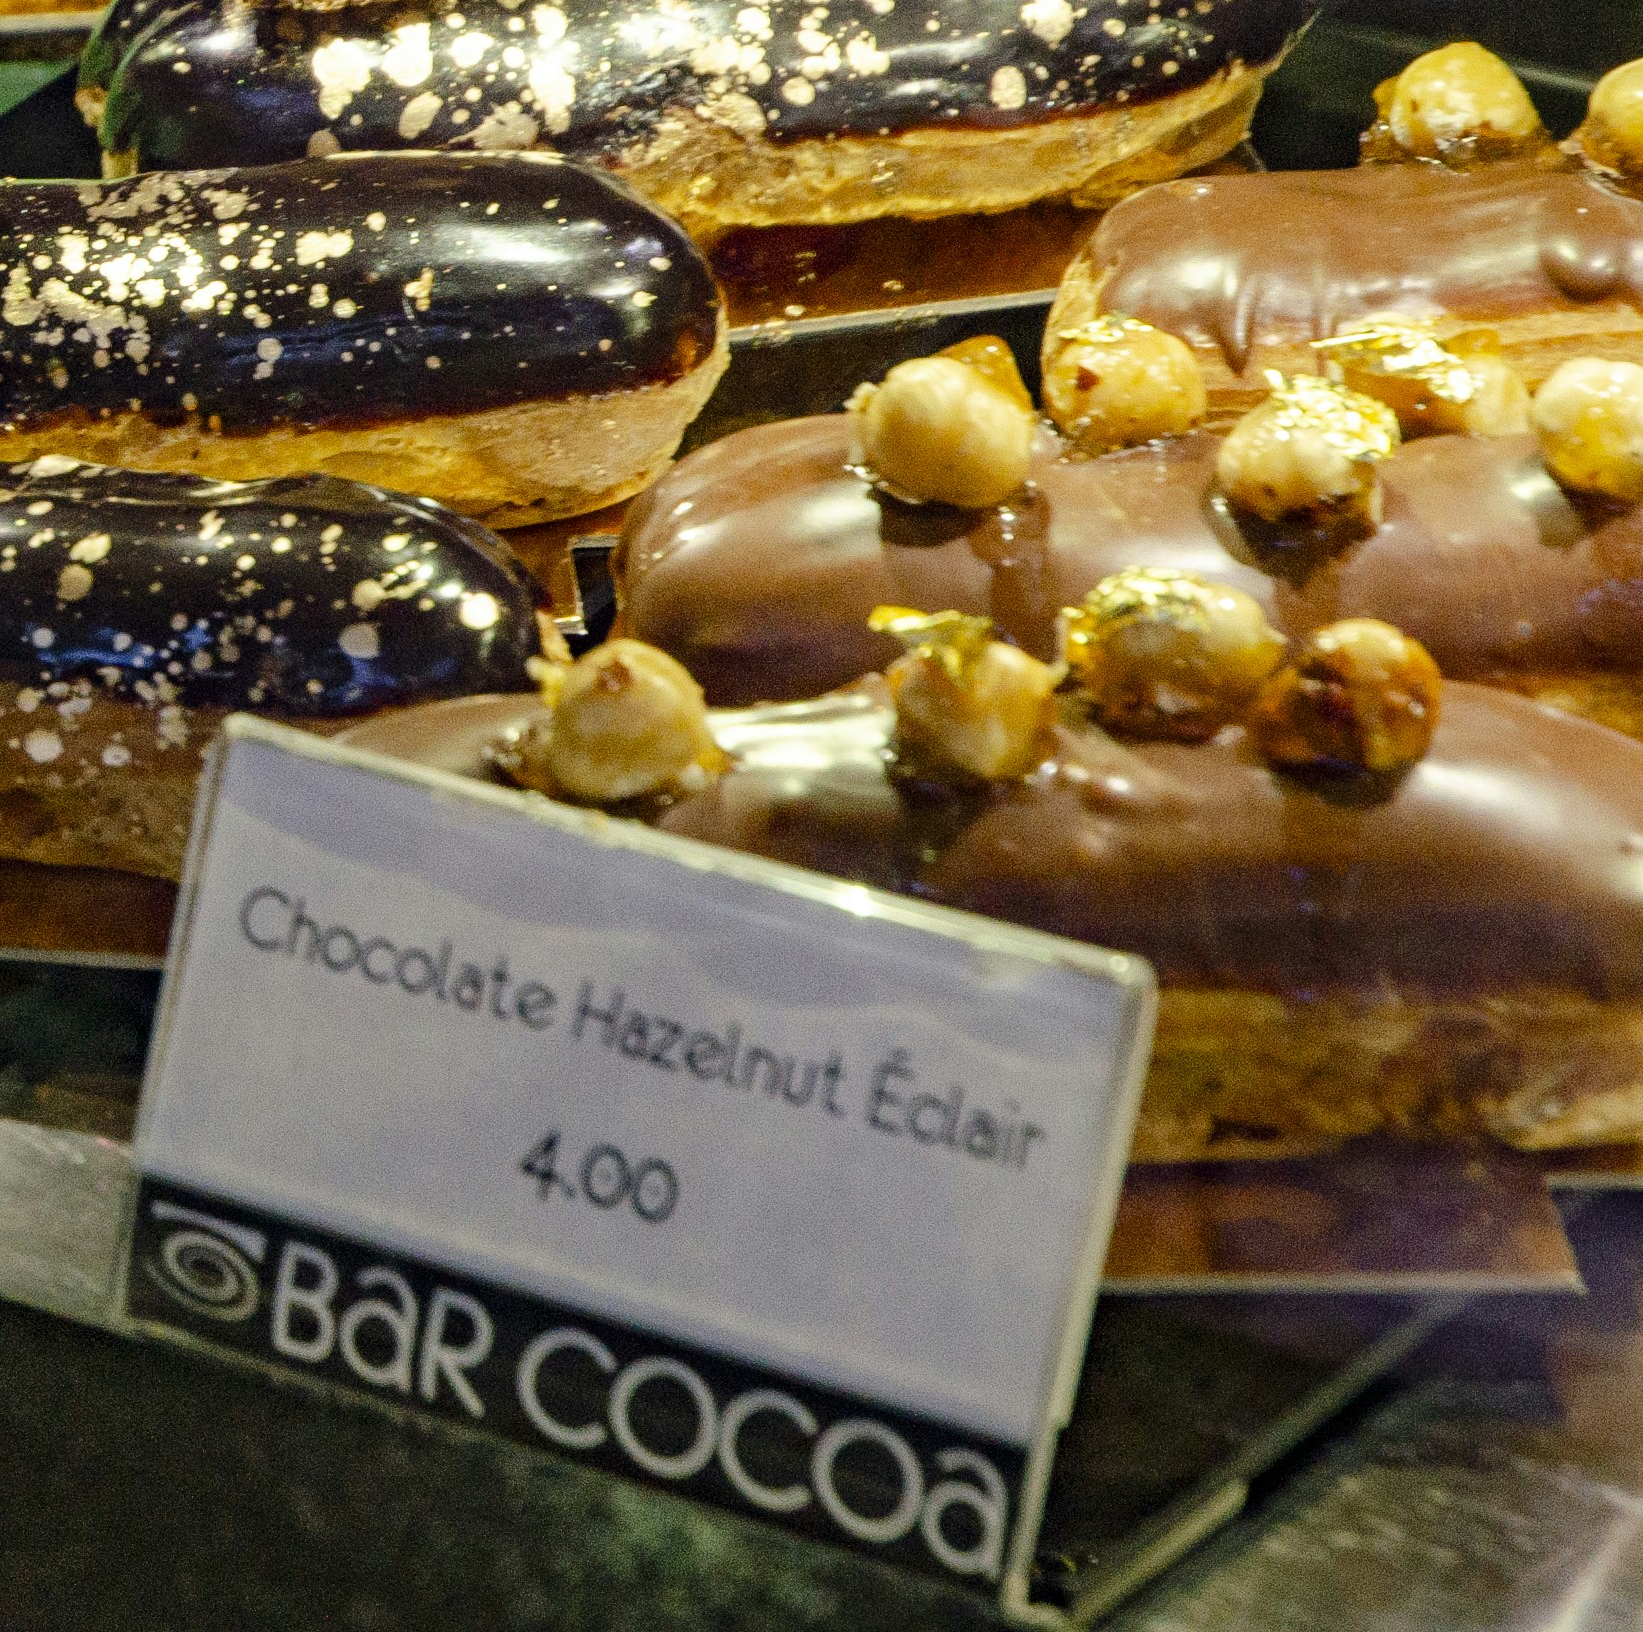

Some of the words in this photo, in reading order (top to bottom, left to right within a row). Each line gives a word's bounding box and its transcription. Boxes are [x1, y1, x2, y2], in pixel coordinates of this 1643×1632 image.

[239, 885, 556, 1030] Chocolate
[572, 979, 848, 1120] Hazelnut
[868, 1048, 1046, 1170] Éclair
[520, 1129, 680, 1223] 4.00
